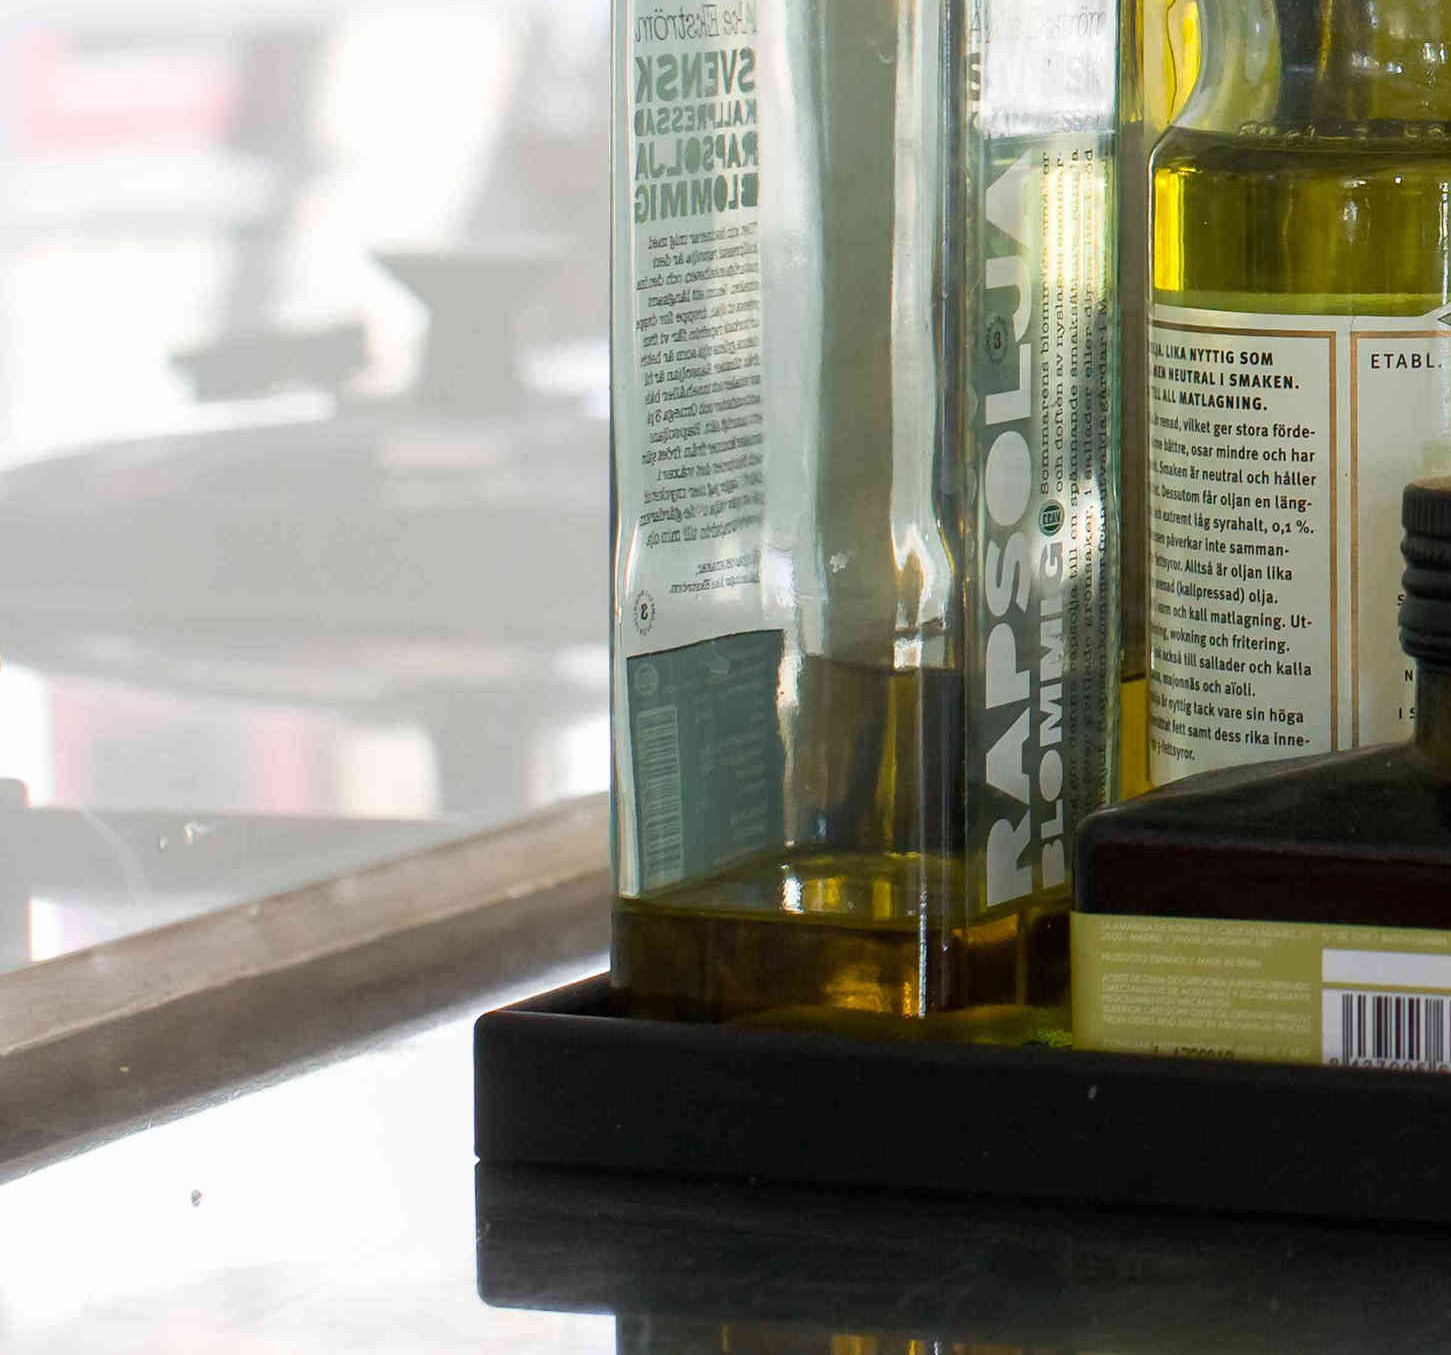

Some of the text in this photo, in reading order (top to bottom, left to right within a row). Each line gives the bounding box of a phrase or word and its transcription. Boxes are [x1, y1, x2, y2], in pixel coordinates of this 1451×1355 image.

[1166, 345, 1273, 365] LIKA NYTTIG SOM
[1370, 352, 1442, 370] ETABL.
[1168, 368, 1215, 385] NEUTRAL
[1220, 372, 1224, 385] I
[1230, 373, 1299, 389] SMAKEN.
[1163, 389, 1176, 403] ALL
[1179, 391, 1267, 411] MATLAGNING.
[1041, 361, 1050, 494] Sommarens
[1183, 418, 1210, 433] vilket
[1214, 423, 1232, 437] ger
[1236, 423, 1268, 437] stora
[1273, 423, 1315, 438] förde-
[1191, 445, 1212, 457] osar
[1216, 445, 1258, 460] mindre
[1263, 448, 1286, 461] och
[1291, 448, 1315, 462] har
[1159, 461, 1187, 478] Smaken
[1190, 466, 1199, 479] är
[1202, 469, 1242, 483] neutral
[1247, 470, 1269, 484] och
[1274, 471, 1316, 486] håller
[1202, 490, 1216, 505] får
[1220, 493, 1250, 509] oljan
[1255, 497, 1270, 508] en
[1276, 496, 1312, 513] läng-
[985, 148, 1033, 906] RAPSOLJA
[1163, 511, 1191, 526] extremt
[1194, 513, 1210, 531] låg
[1213, 517, 1267, 534] syrahalt,
[1272, 522, 1292, 535] 0,1
[1296, 519, 1314, 534] %.
[1167, 533, 1202, 551] påverkar
[1205, 538, 1226, 553] inte
[1230, 543, 1289, 556] samman-
[1185, 559, 1213, 575] Alltså
[1216, 563, 1227, 576] är
[1231, 565, 1262, 581] oljan
[1267, 566, 1292, 581] lika
[1177, 580, 1245, 603] (kallpressad)
[1249, 591, 1278, 606] olja.
[1173, 606, 1187, 619] och
[1190, 606, 1207, 622] kall
[1211, 611, 1286, 630] matlagning.
[1290, 615, 1312, 628] Ut-
[1170, 629, 1206, 648] wokning
[1209, 634, 1229, 647] och
[1232, 635, 1290, 654] fritering.
[1184, 652, 1197, 667] till
[1200, 657, 1245, 672] sallader
[1249, 661, 1271, 674] och
[1277, 662, 1312, 676] kalla
[1163, 672, 1200, 690] majonnäs
[1203, 681, 1221, 694] och
[1225, 683, 1255, 697] aïoli.
[1039, 542, 1065, 891] BLOMMIG
[1168, 697, 1191, 716] nyttig
[1194, 702, 1214, 717] tack
[1217, 707, 1242, 719] vare
[1246, 707, 1265, 721] sin
[1270, 708, 1304, 725] höga
[1172, 720, 1185, 736] fett
[1187, 726, 1211, 740] samt
[1215, 728, 1241, 743] dess
[1245, 731, 1269, 745] rika
[1274, 732, 1310, 747] inne-
